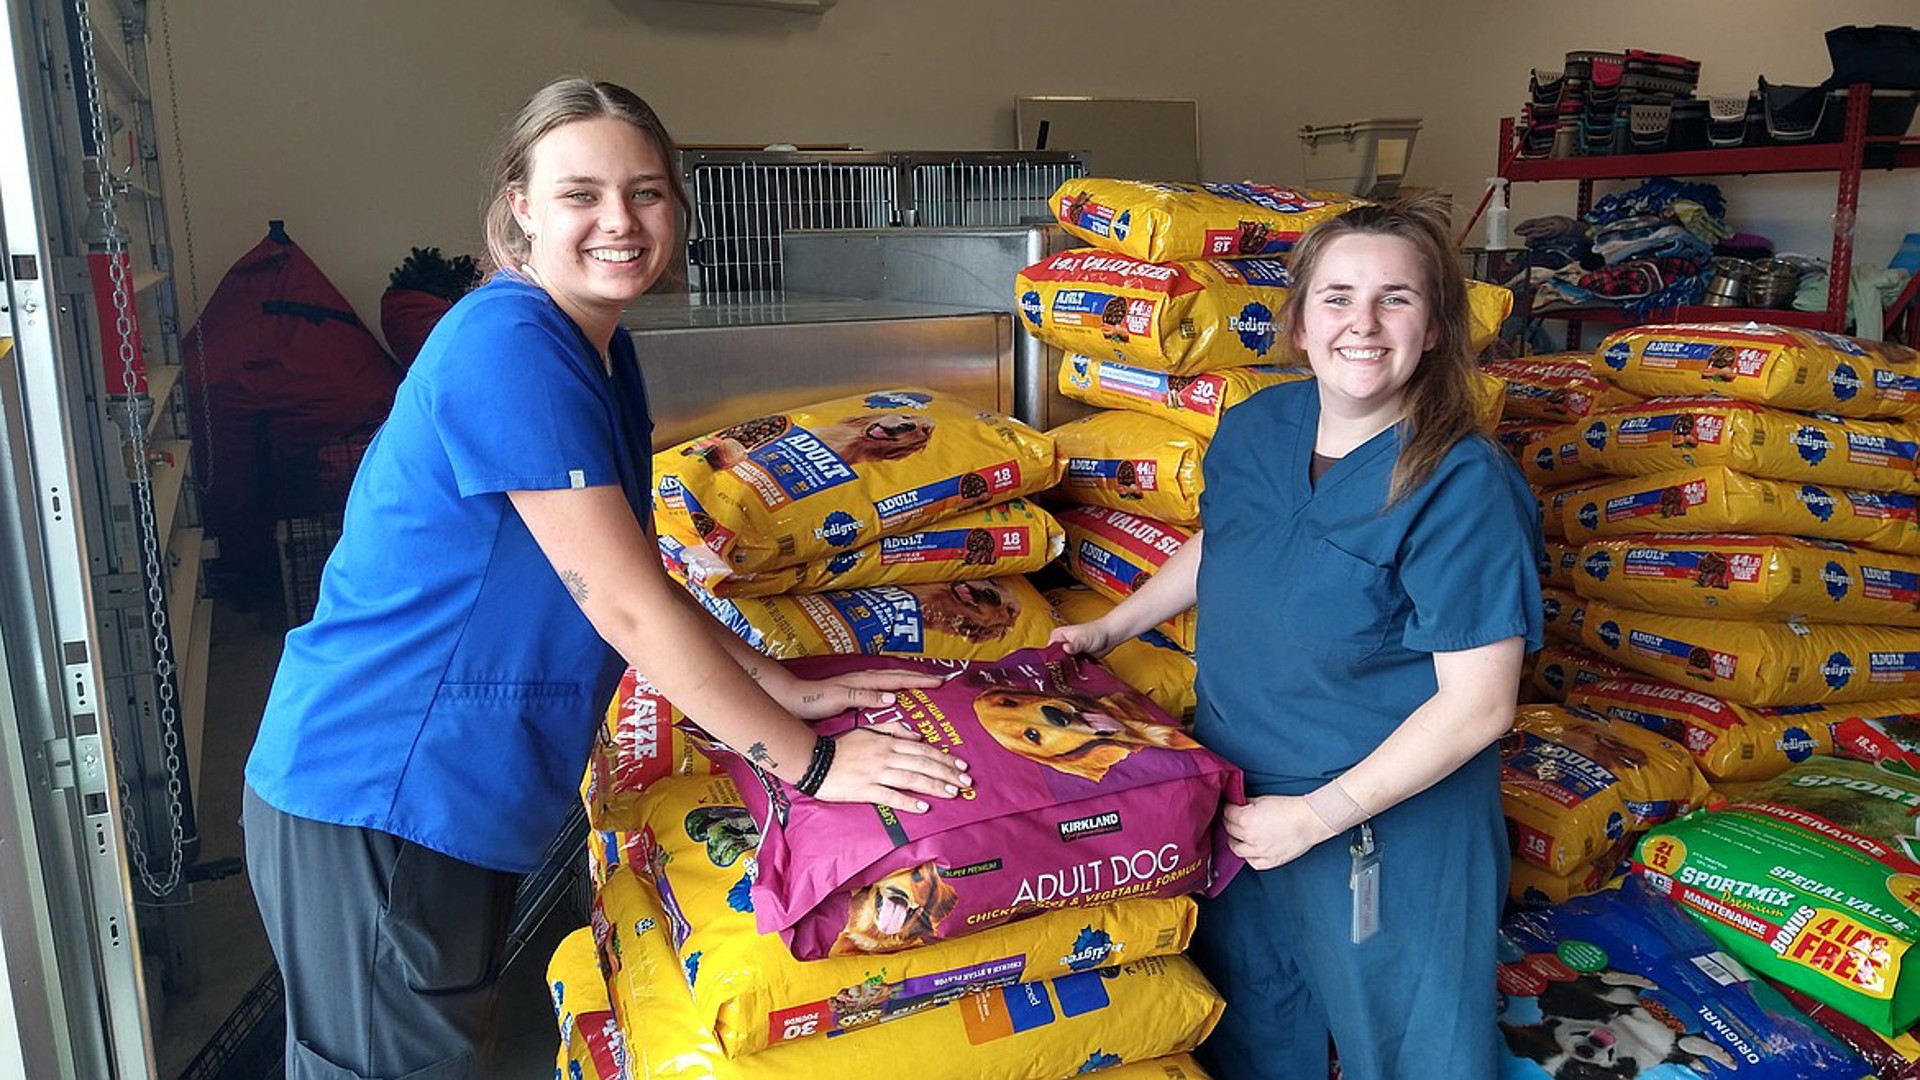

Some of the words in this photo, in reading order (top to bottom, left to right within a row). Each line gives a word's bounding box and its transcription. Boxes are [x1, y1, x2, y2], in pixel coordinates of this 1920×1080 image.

[1213, 240, 1231, 253] 18
[1647, 341, 1684, 354] ADULT
[1192, 380, 1214, 397] 30
[1789, 433, 1835, 450] Pedigree
[784, 432, 852, 480] ADULT
[993, 467, 1013, 484] 18
[878, 490, 919, 514] ADULT
[814, 517, 865, 541] Pedigree
[1003, 532, 1021, 546] 18
[1107, 511, 1164, 545] VALUE
[883, 533, 926, 550] ADULT
[1628, 549, 1669, 561] ADULT
[1730, 554, 1761, 567] 44LB
[1630, 631, 1663, 647] ADULT
[1872, 653, 1906, 666] ADULT
[1629, 683, 1684, 701] VALUE
[1680, 692, 1726, 713] SIZE
[634, 699, 657, 761] SIZE
[917, 719, 942, 743] RICE
[940, 720, 964, 746] MADE
[1534, 743, 1613, 782] ADULT
[1061, 813, 1119, 835] KIRKLAND
[1526, 835, 1547, 854] 18
[1656, 841, 1674, 856] 21
[1652, 853, 1669, 870] 12
[1012, 860, 1104, 906] ADULT
[1111, 843, 1180, 886] DOG
[1070, 896, 1079, 906] &
[1085, 882, 1153, 904] VEGETABLE
[1154, 858, 1203, 892] FORMULA
[1720, 889, 1785, 918] Premium
[1770, 865, 1846, 902] SPECIAL
[1844, 895, 1910, 933] VALUE
[1682, 889, 1768, 935] MAINTENANCE
[1769, 905, 1817, 955] BONUS
[1815, 916, 1840, 937] 4
[1059, 940, 1124, 967] Pedigree
[783, 1012, 819, 1026] POUNDS
[783, 1021, 818, 1040] 30
[1697, 1004, 1761, 1065] ORIGINAL
